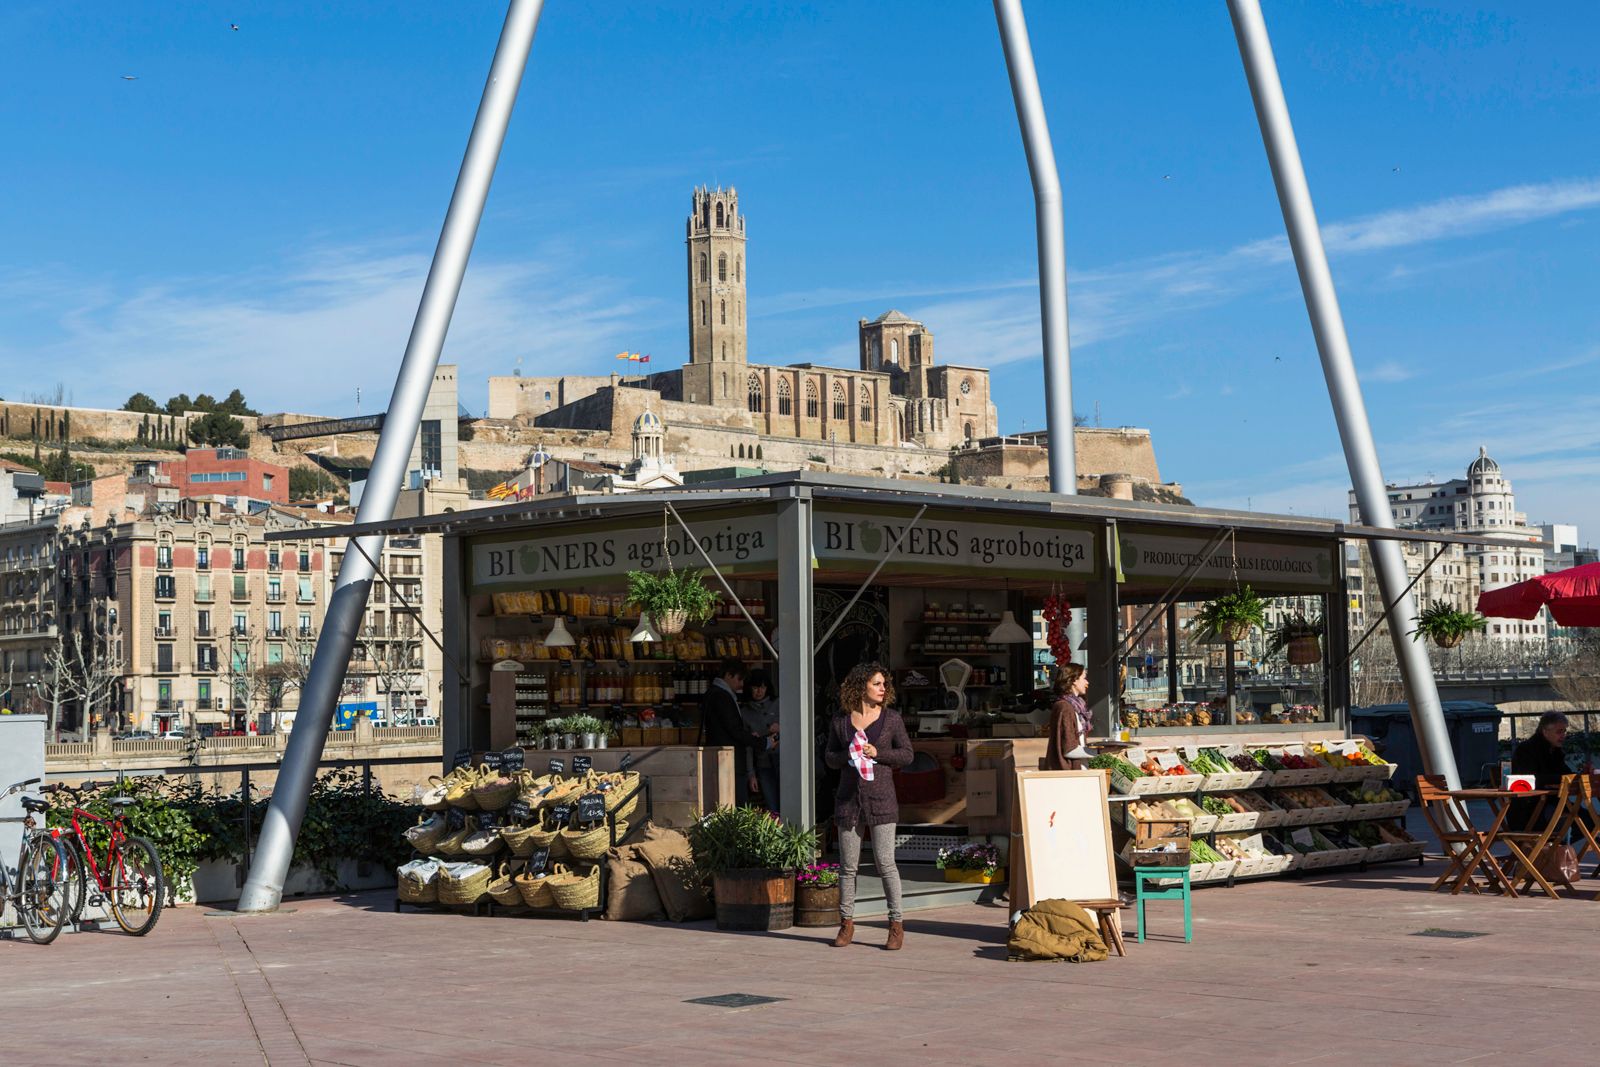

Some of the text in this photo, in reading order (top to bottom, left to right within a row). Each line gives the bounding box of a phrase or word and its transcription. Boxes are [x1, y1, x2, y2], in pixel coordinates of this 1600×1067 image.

[627, 525, 765, 569] agrobotiga
[970, 531, 1085, 568] agrobotiga
[1143, 551, 1203, 566] PRODUCTES
